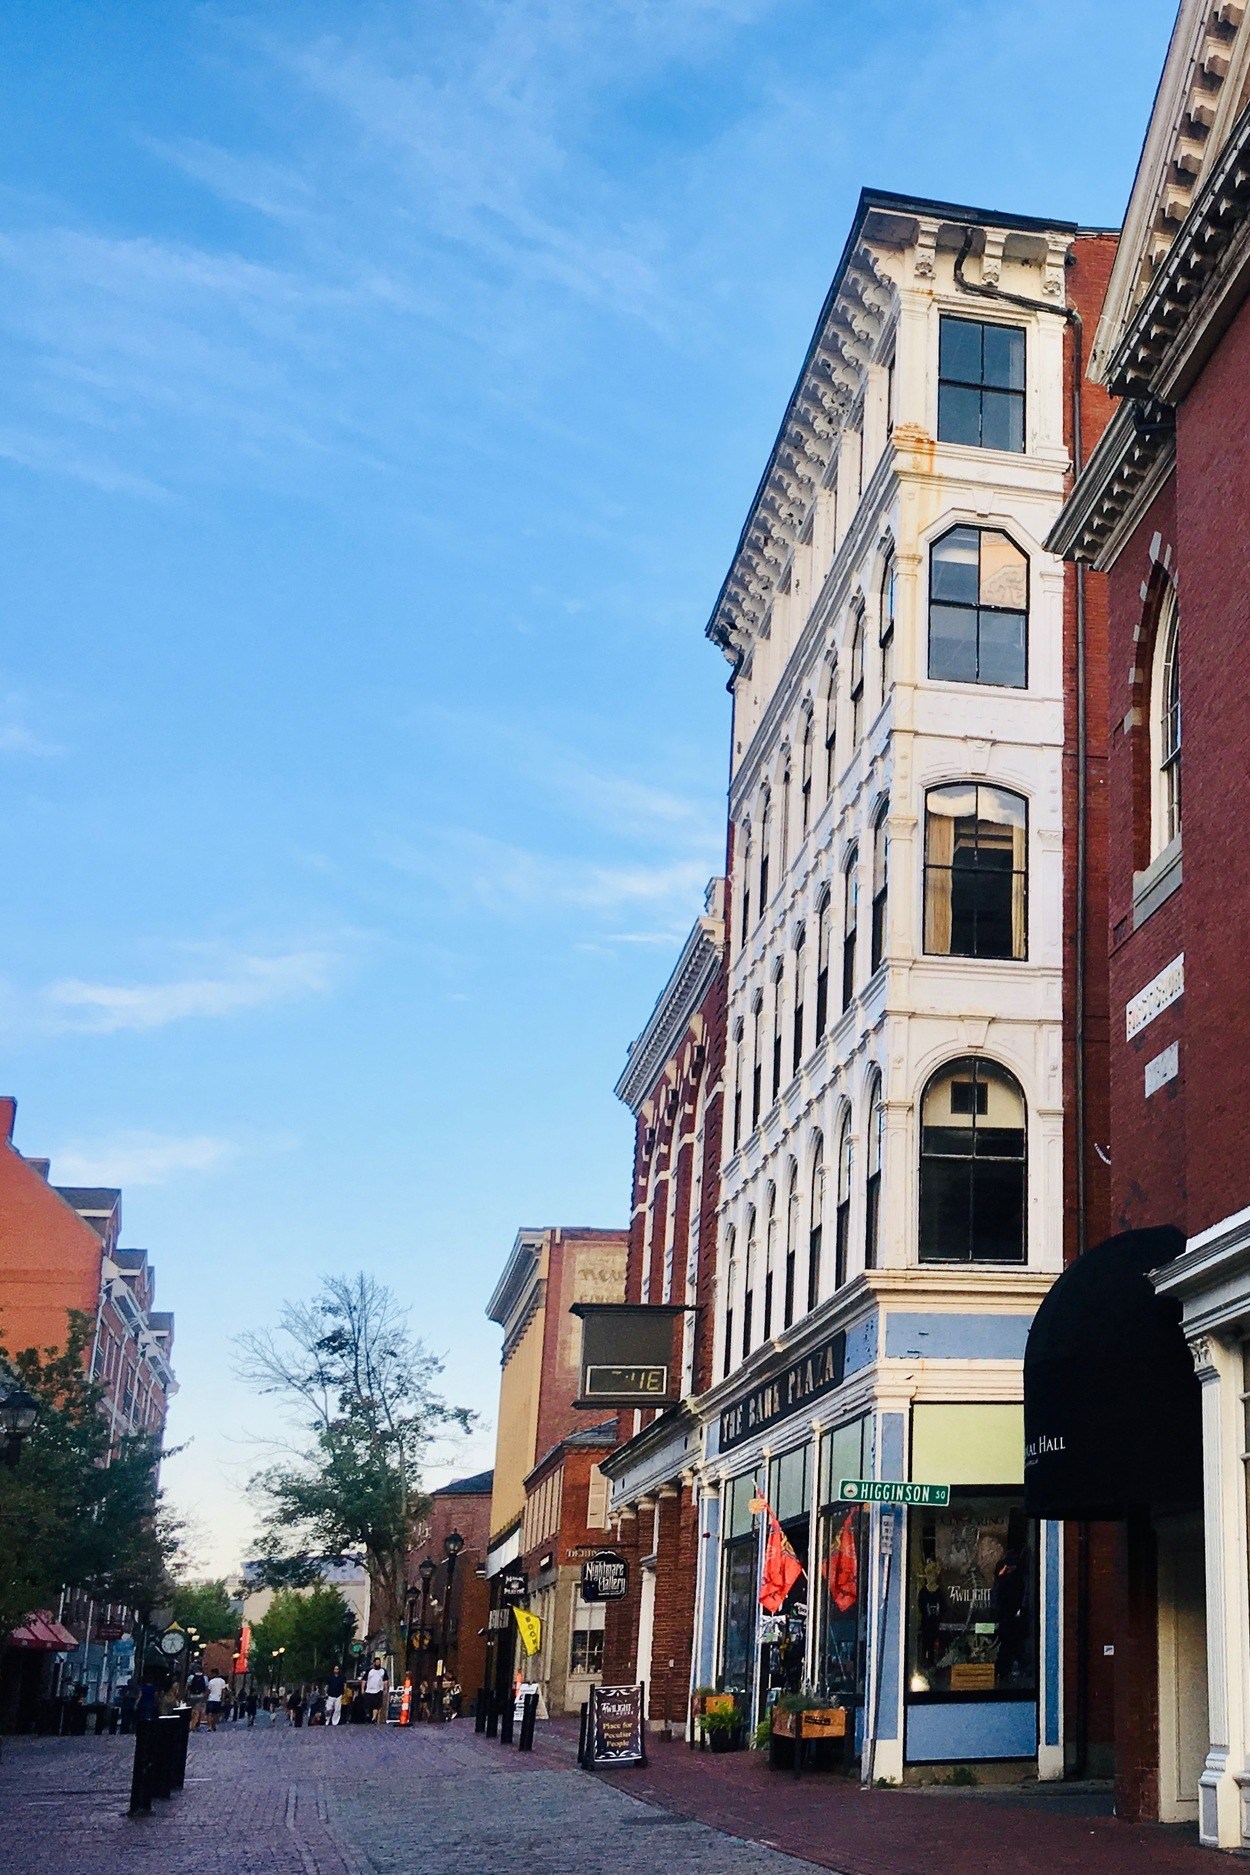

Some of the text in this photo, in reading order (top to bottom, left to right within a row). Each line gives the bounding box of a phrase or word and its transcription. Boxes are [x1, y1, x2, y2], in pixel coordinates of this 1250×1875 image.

[723, 1405, 743, 1442] THE
[1039, 1435, 1066, 1453] HALL
[861, 1483, 930, 1502] HIGGINSON
[585, 1560, 625, 1582] Nightmare
[602, 1721, 633, 1730] Place for
[604, 1731, 632, 1739] Peculiar
[606, 1740, 630, 1748] People
